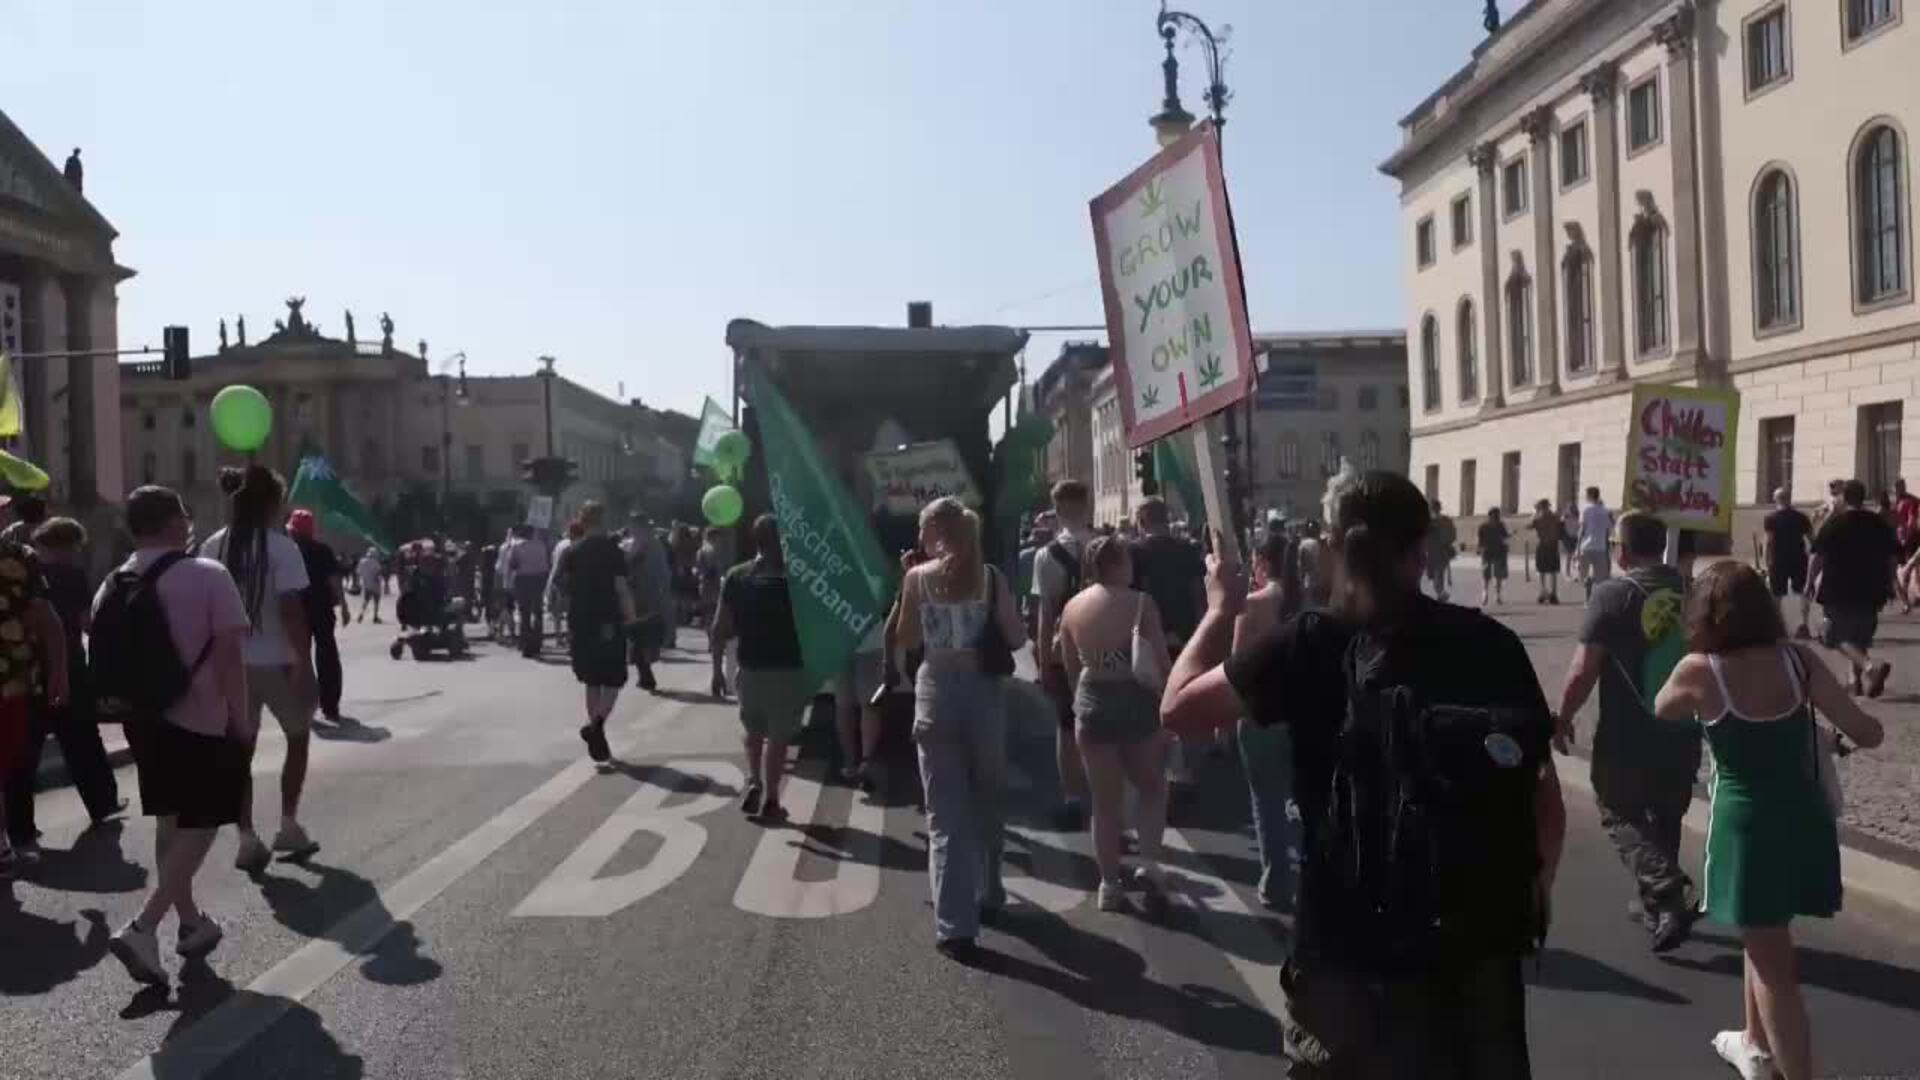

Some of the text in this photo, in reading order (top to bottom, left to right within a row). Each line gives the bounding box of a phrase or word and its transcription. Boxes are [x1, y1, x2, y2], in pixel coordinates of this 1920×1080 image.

[1119, 200, 1201, 276] GROW
[1134, 253, 1213, 334] YOUR
[1151, 312, 1213, 372] OWN
[1641, 397, 1724, 448] Chillen
